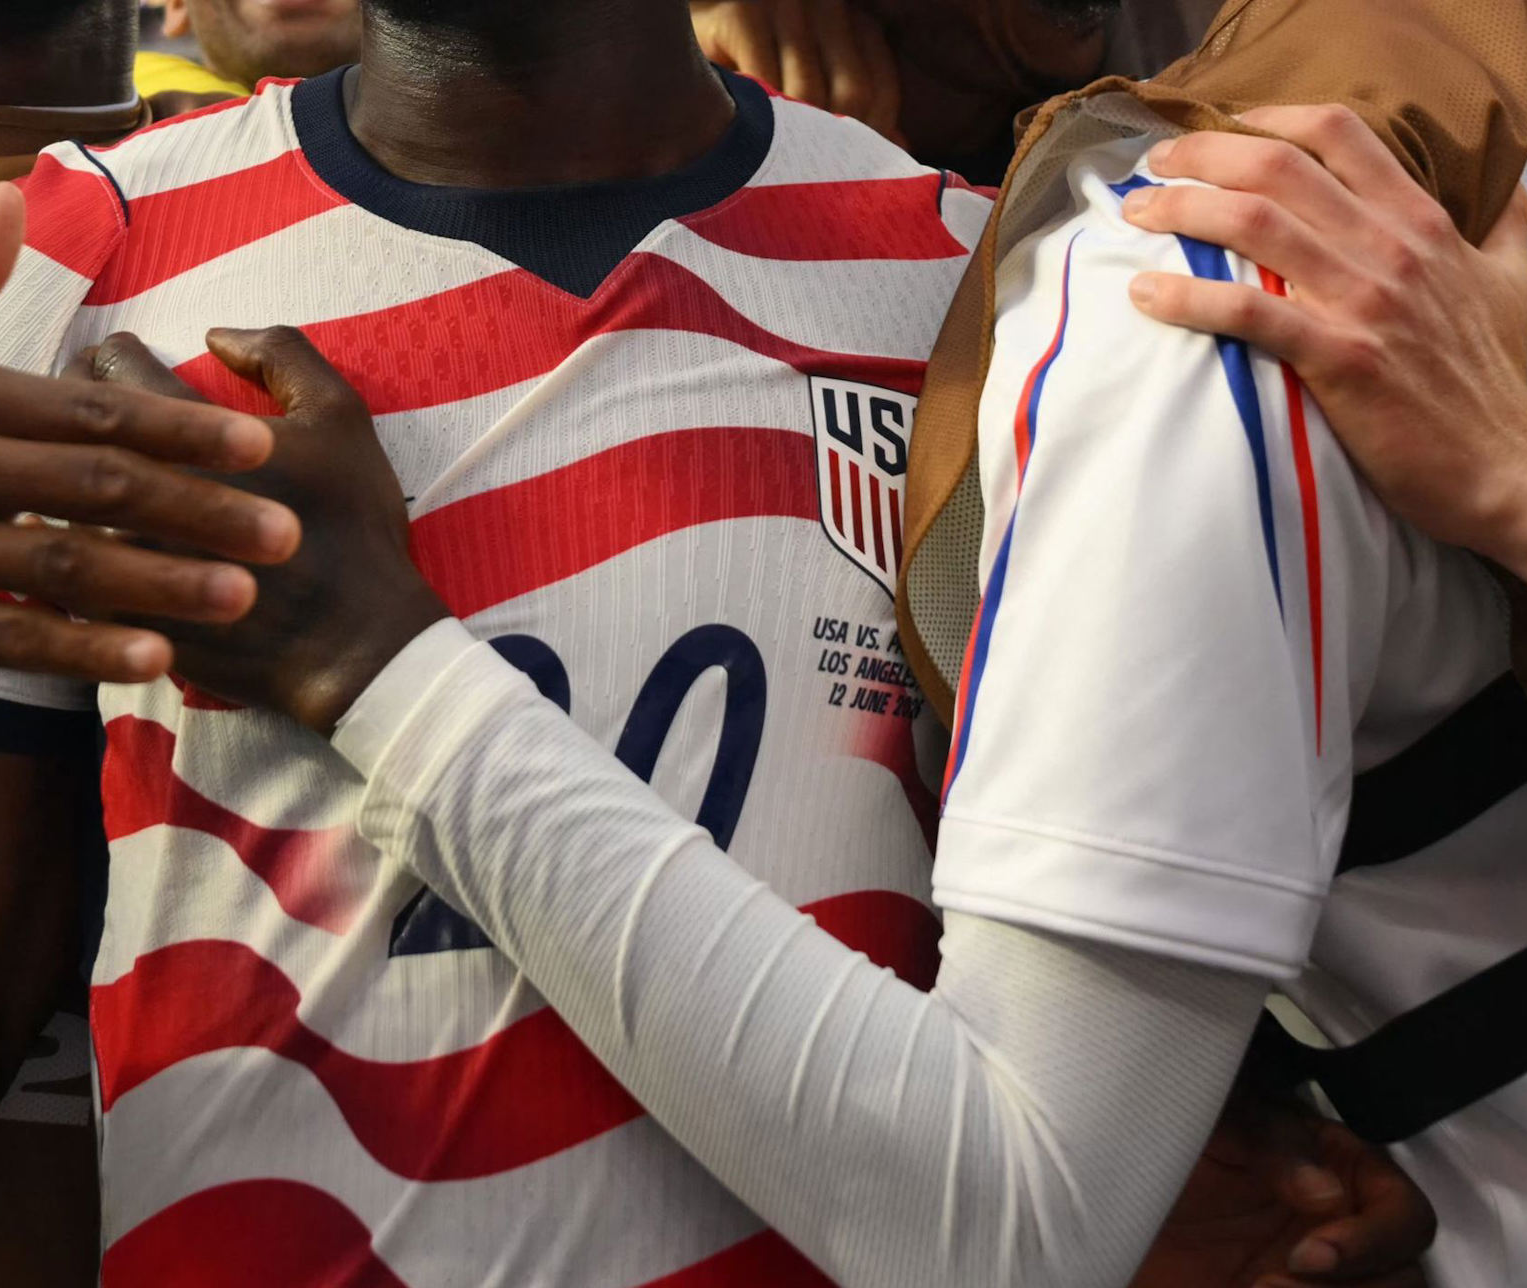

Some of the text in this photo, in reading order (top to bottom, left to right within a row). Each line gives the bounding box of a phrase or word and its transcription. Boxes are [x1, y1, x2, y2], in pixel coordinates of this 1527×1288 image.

[822, 388, 917, 476] US
[813, 617, 849, 644] USA
[856, 624, 880, 650] VS.
[818, 649, 921, 690] LOS ANGELE
[828, 682, 847, 706] 12
[849, 687, 891, 715] JUNE
